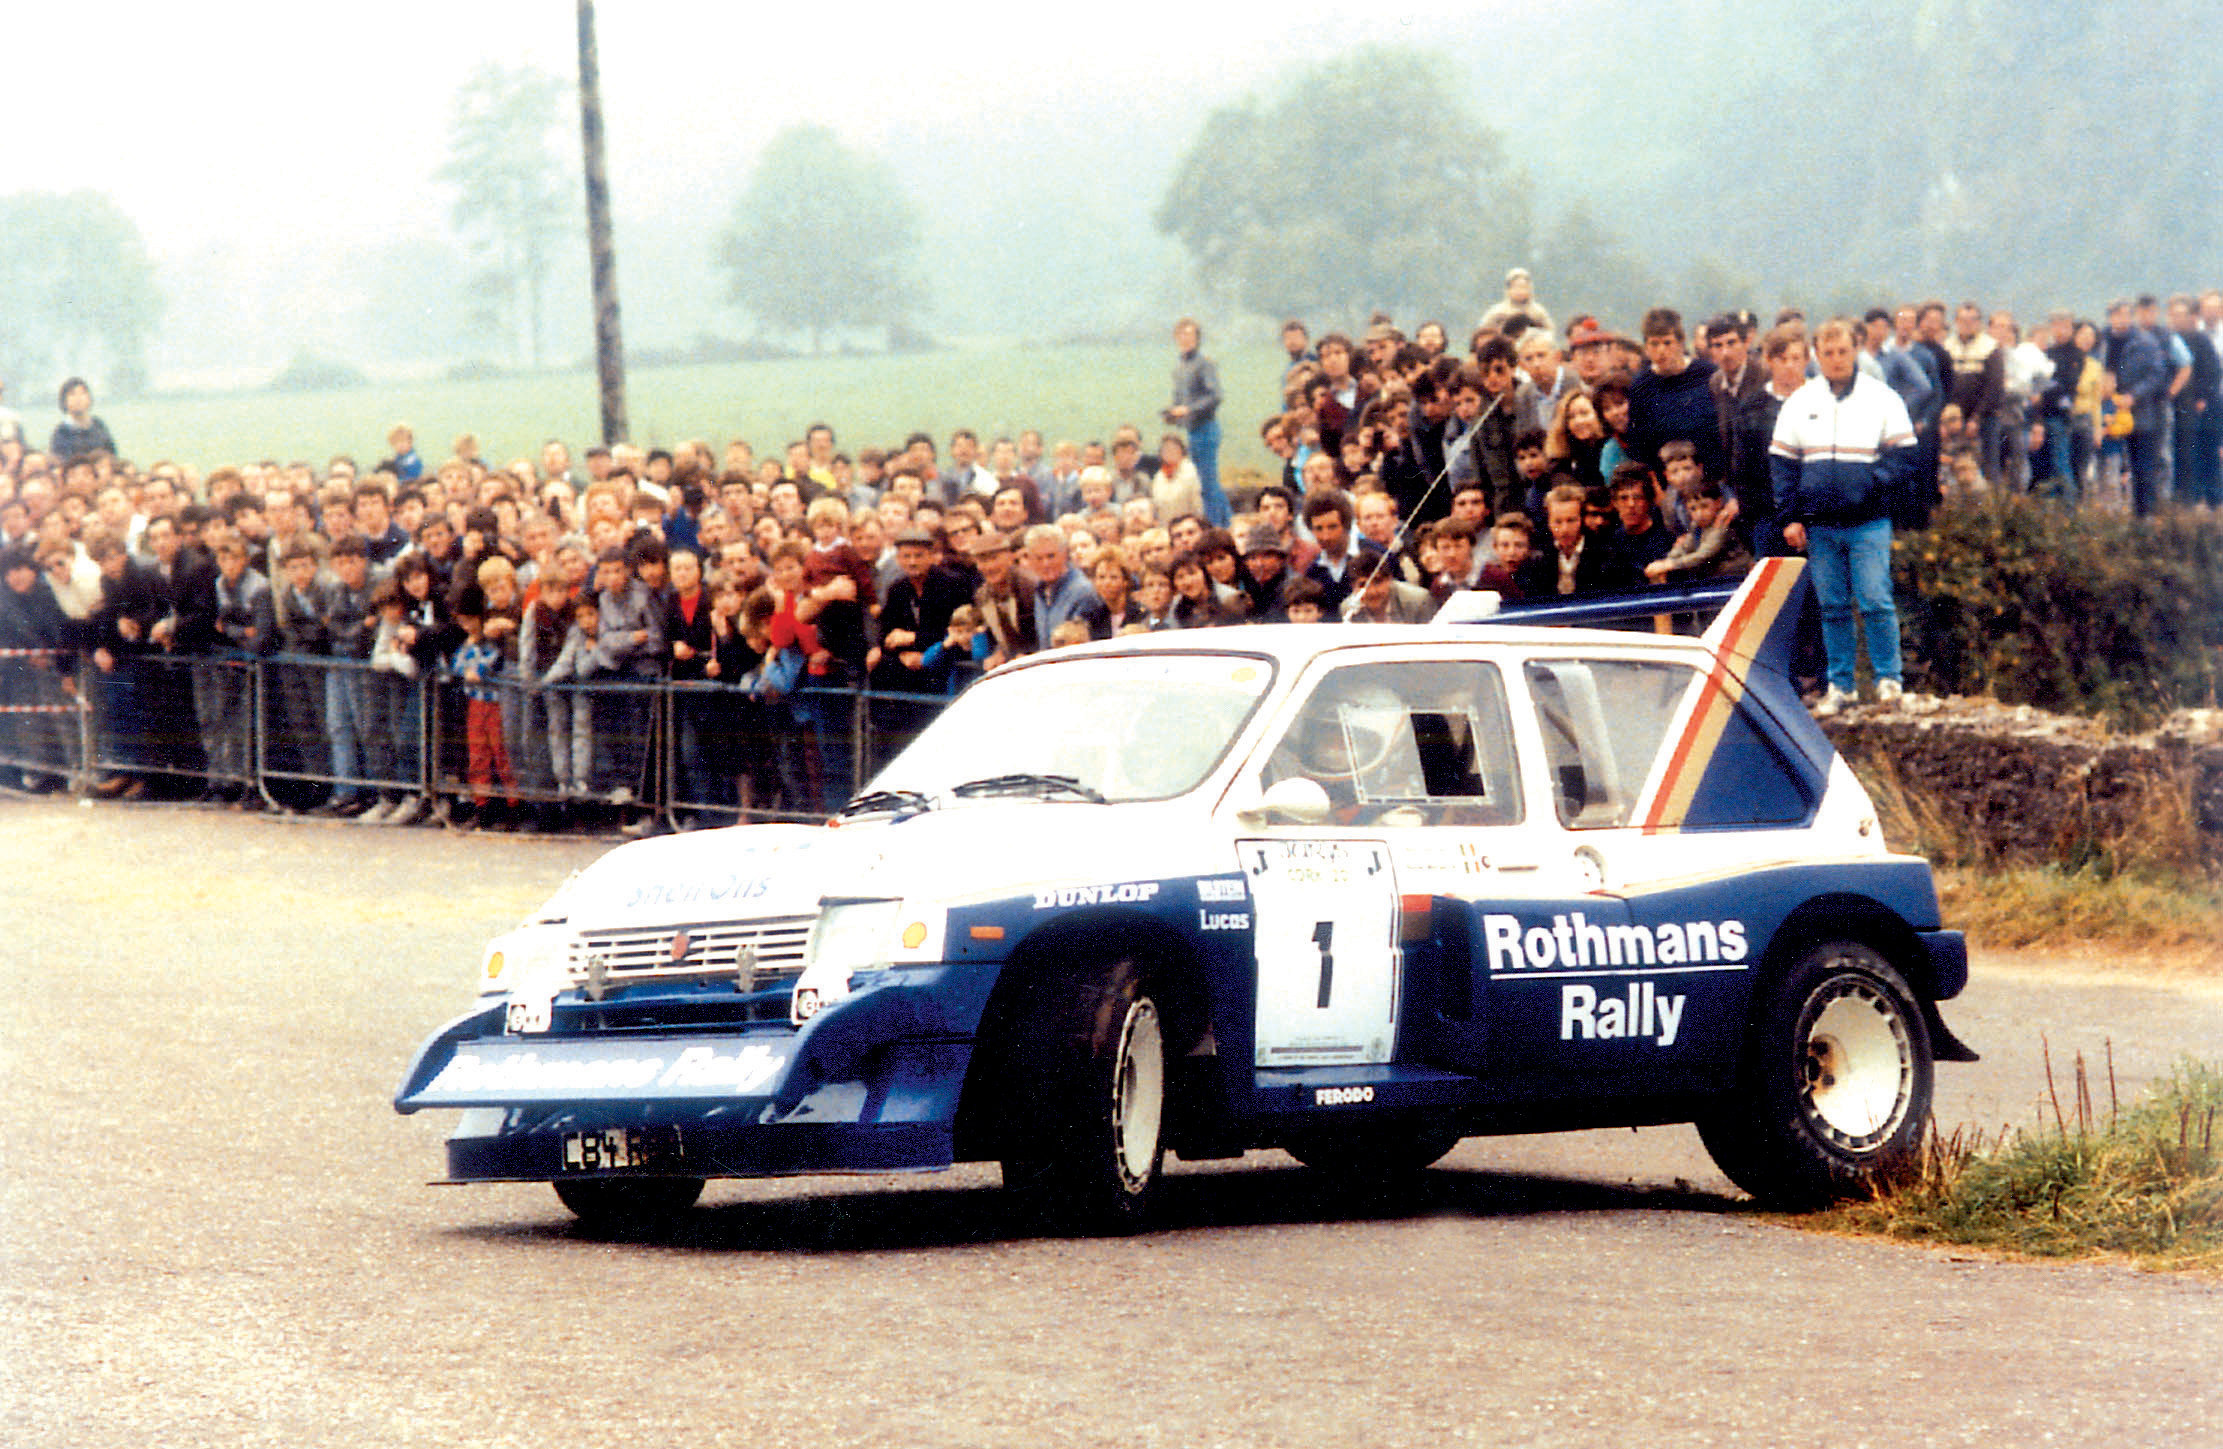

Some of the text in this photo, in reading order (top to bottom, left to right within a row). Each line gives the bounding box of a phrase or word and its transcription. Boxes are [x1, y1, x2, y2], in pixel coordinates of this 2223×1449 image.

[1033, 882, 1160, 910] DUNLOP
[1200, 909, 1250, 931] Lucas
[1483, 912, 1749, 971] Rothmans
[1311, 920, 1334, 1009] 1
[1560, 981, 1686, 1047] Rally
[1315, 1086, 1375, 1106] FERODO
